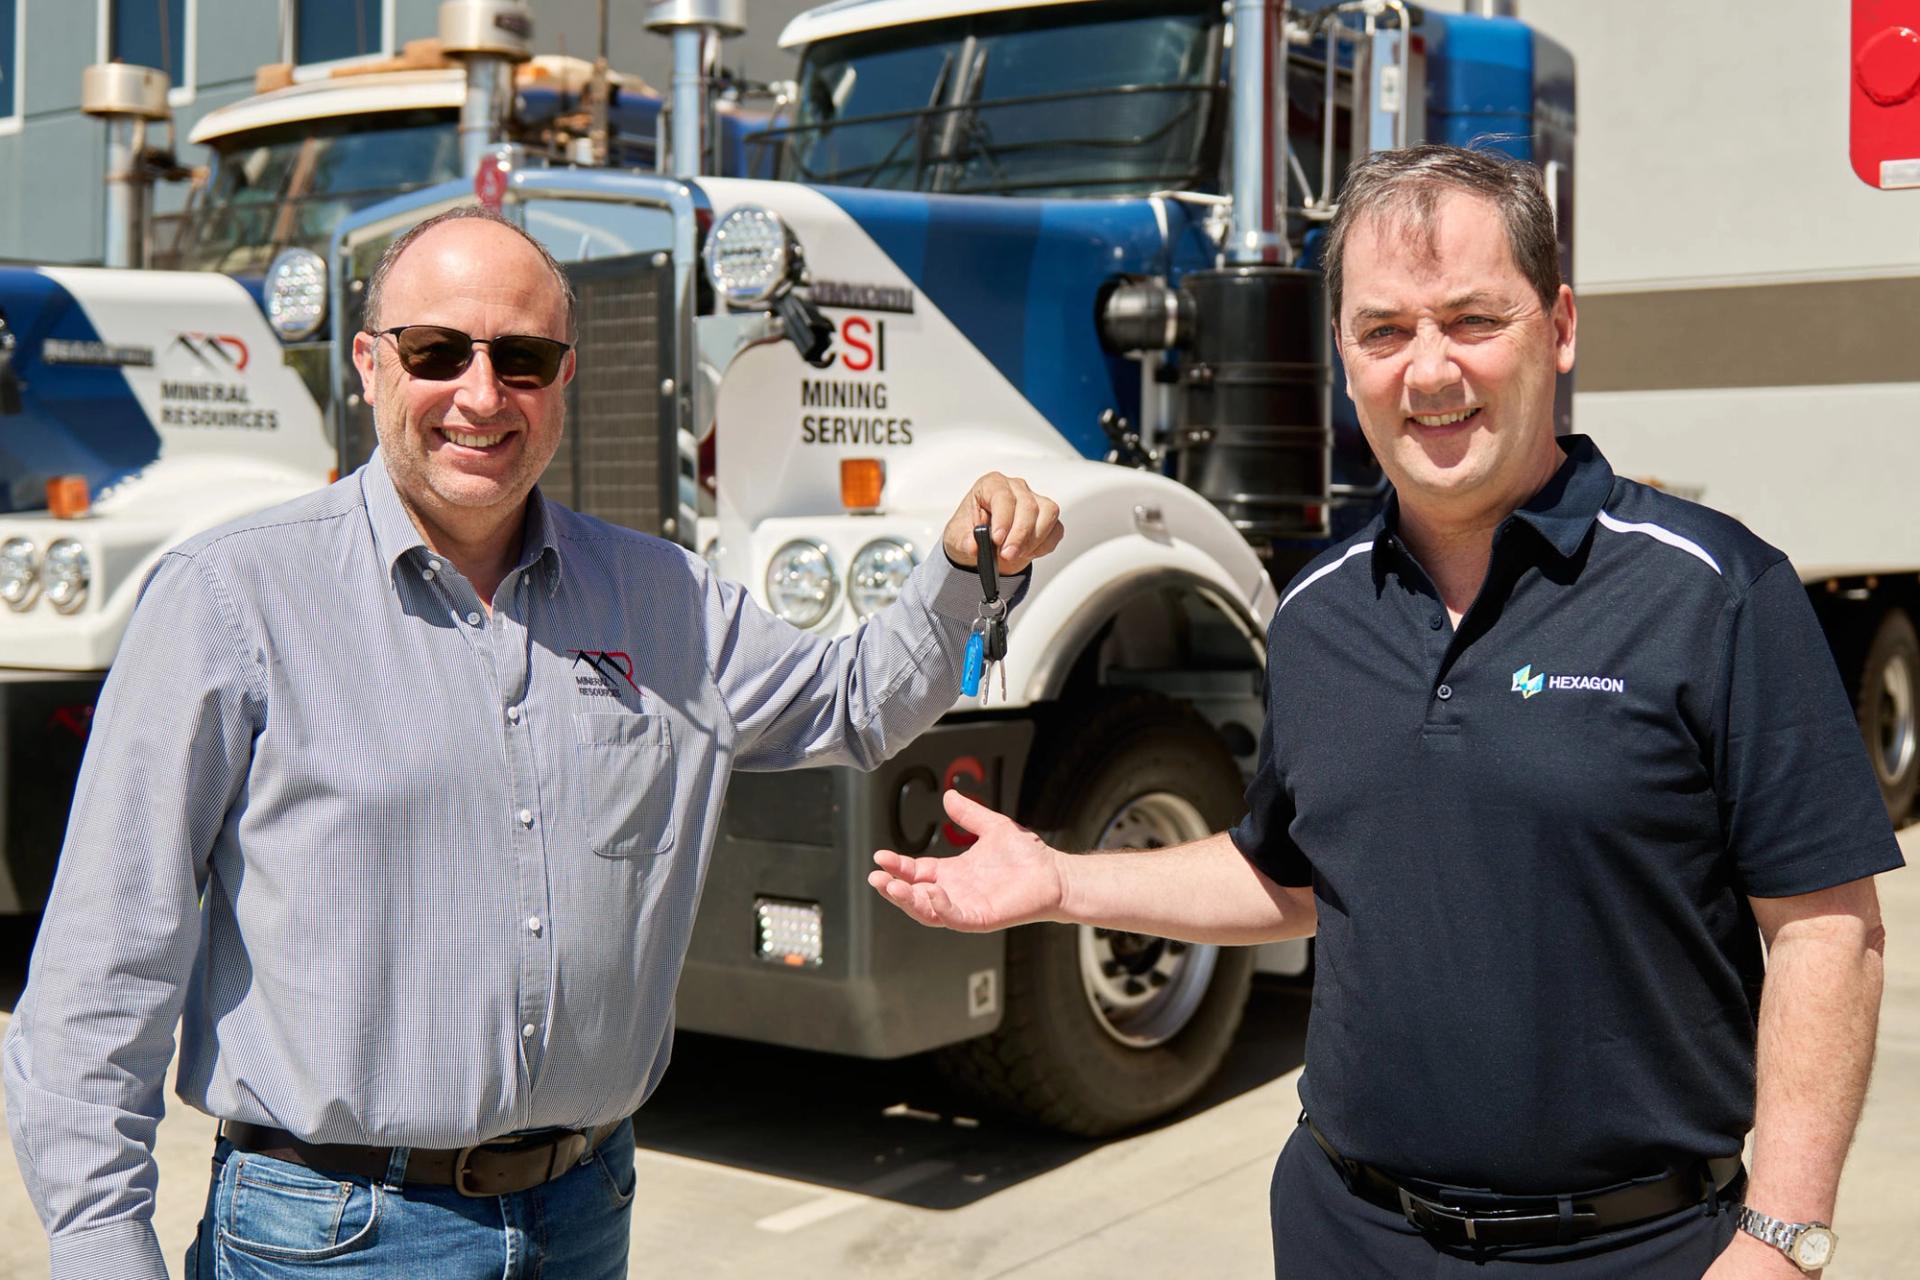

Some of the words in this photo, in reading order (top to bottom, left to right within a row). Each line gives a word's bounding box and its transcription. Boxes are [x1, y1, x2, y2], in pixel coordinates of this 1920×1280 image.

[160, 380, 249, 403] MINERAL
[802, 380, 887, 409] MINING
[161, 406, 279, 430] RESOURCES
[802, 415, 913, 445] SERVICES
[1549, 675, 1624, 693] HEXAGON
